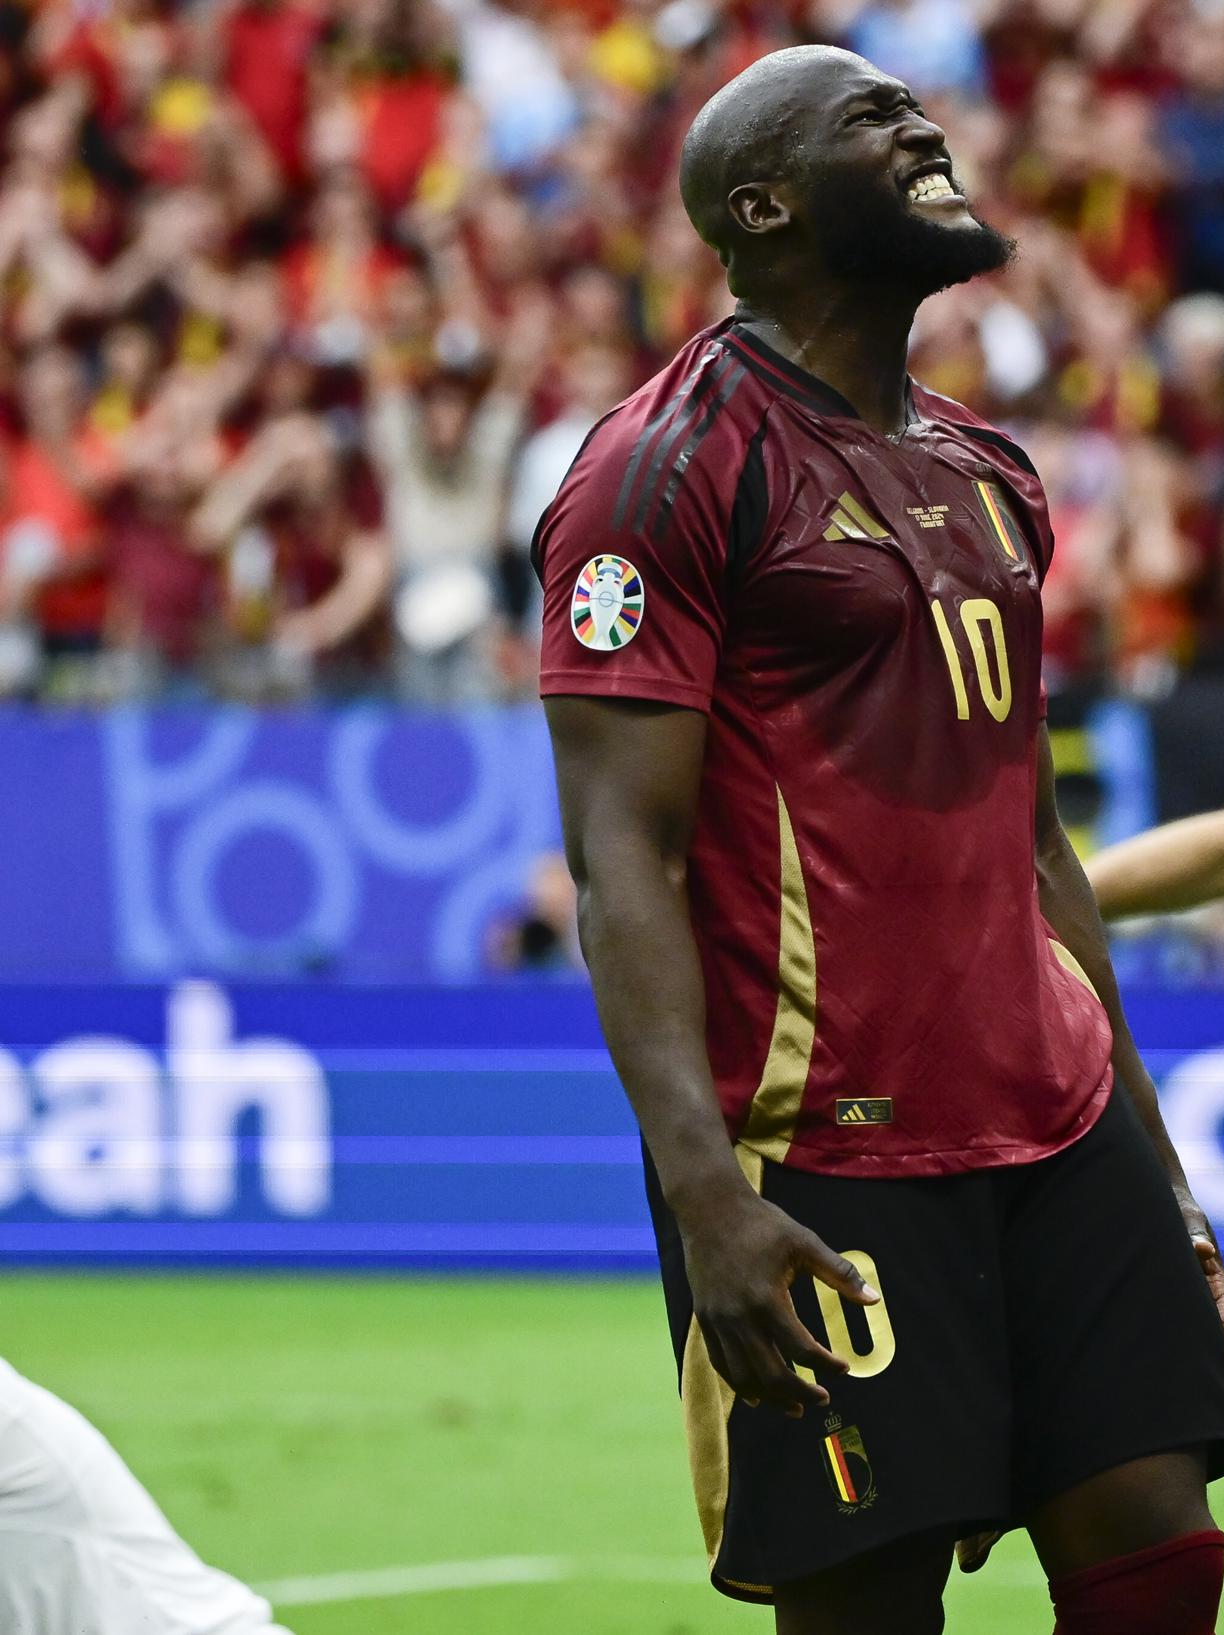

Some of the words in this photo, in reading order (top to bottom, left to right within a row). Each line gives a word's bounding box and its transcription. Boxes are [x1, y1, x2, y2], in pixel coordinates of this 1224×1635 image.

[931, 597, 1012, 723] 10
[0, 981, 333, 1217] ah
[787, 1250, 896, 1386] 0
